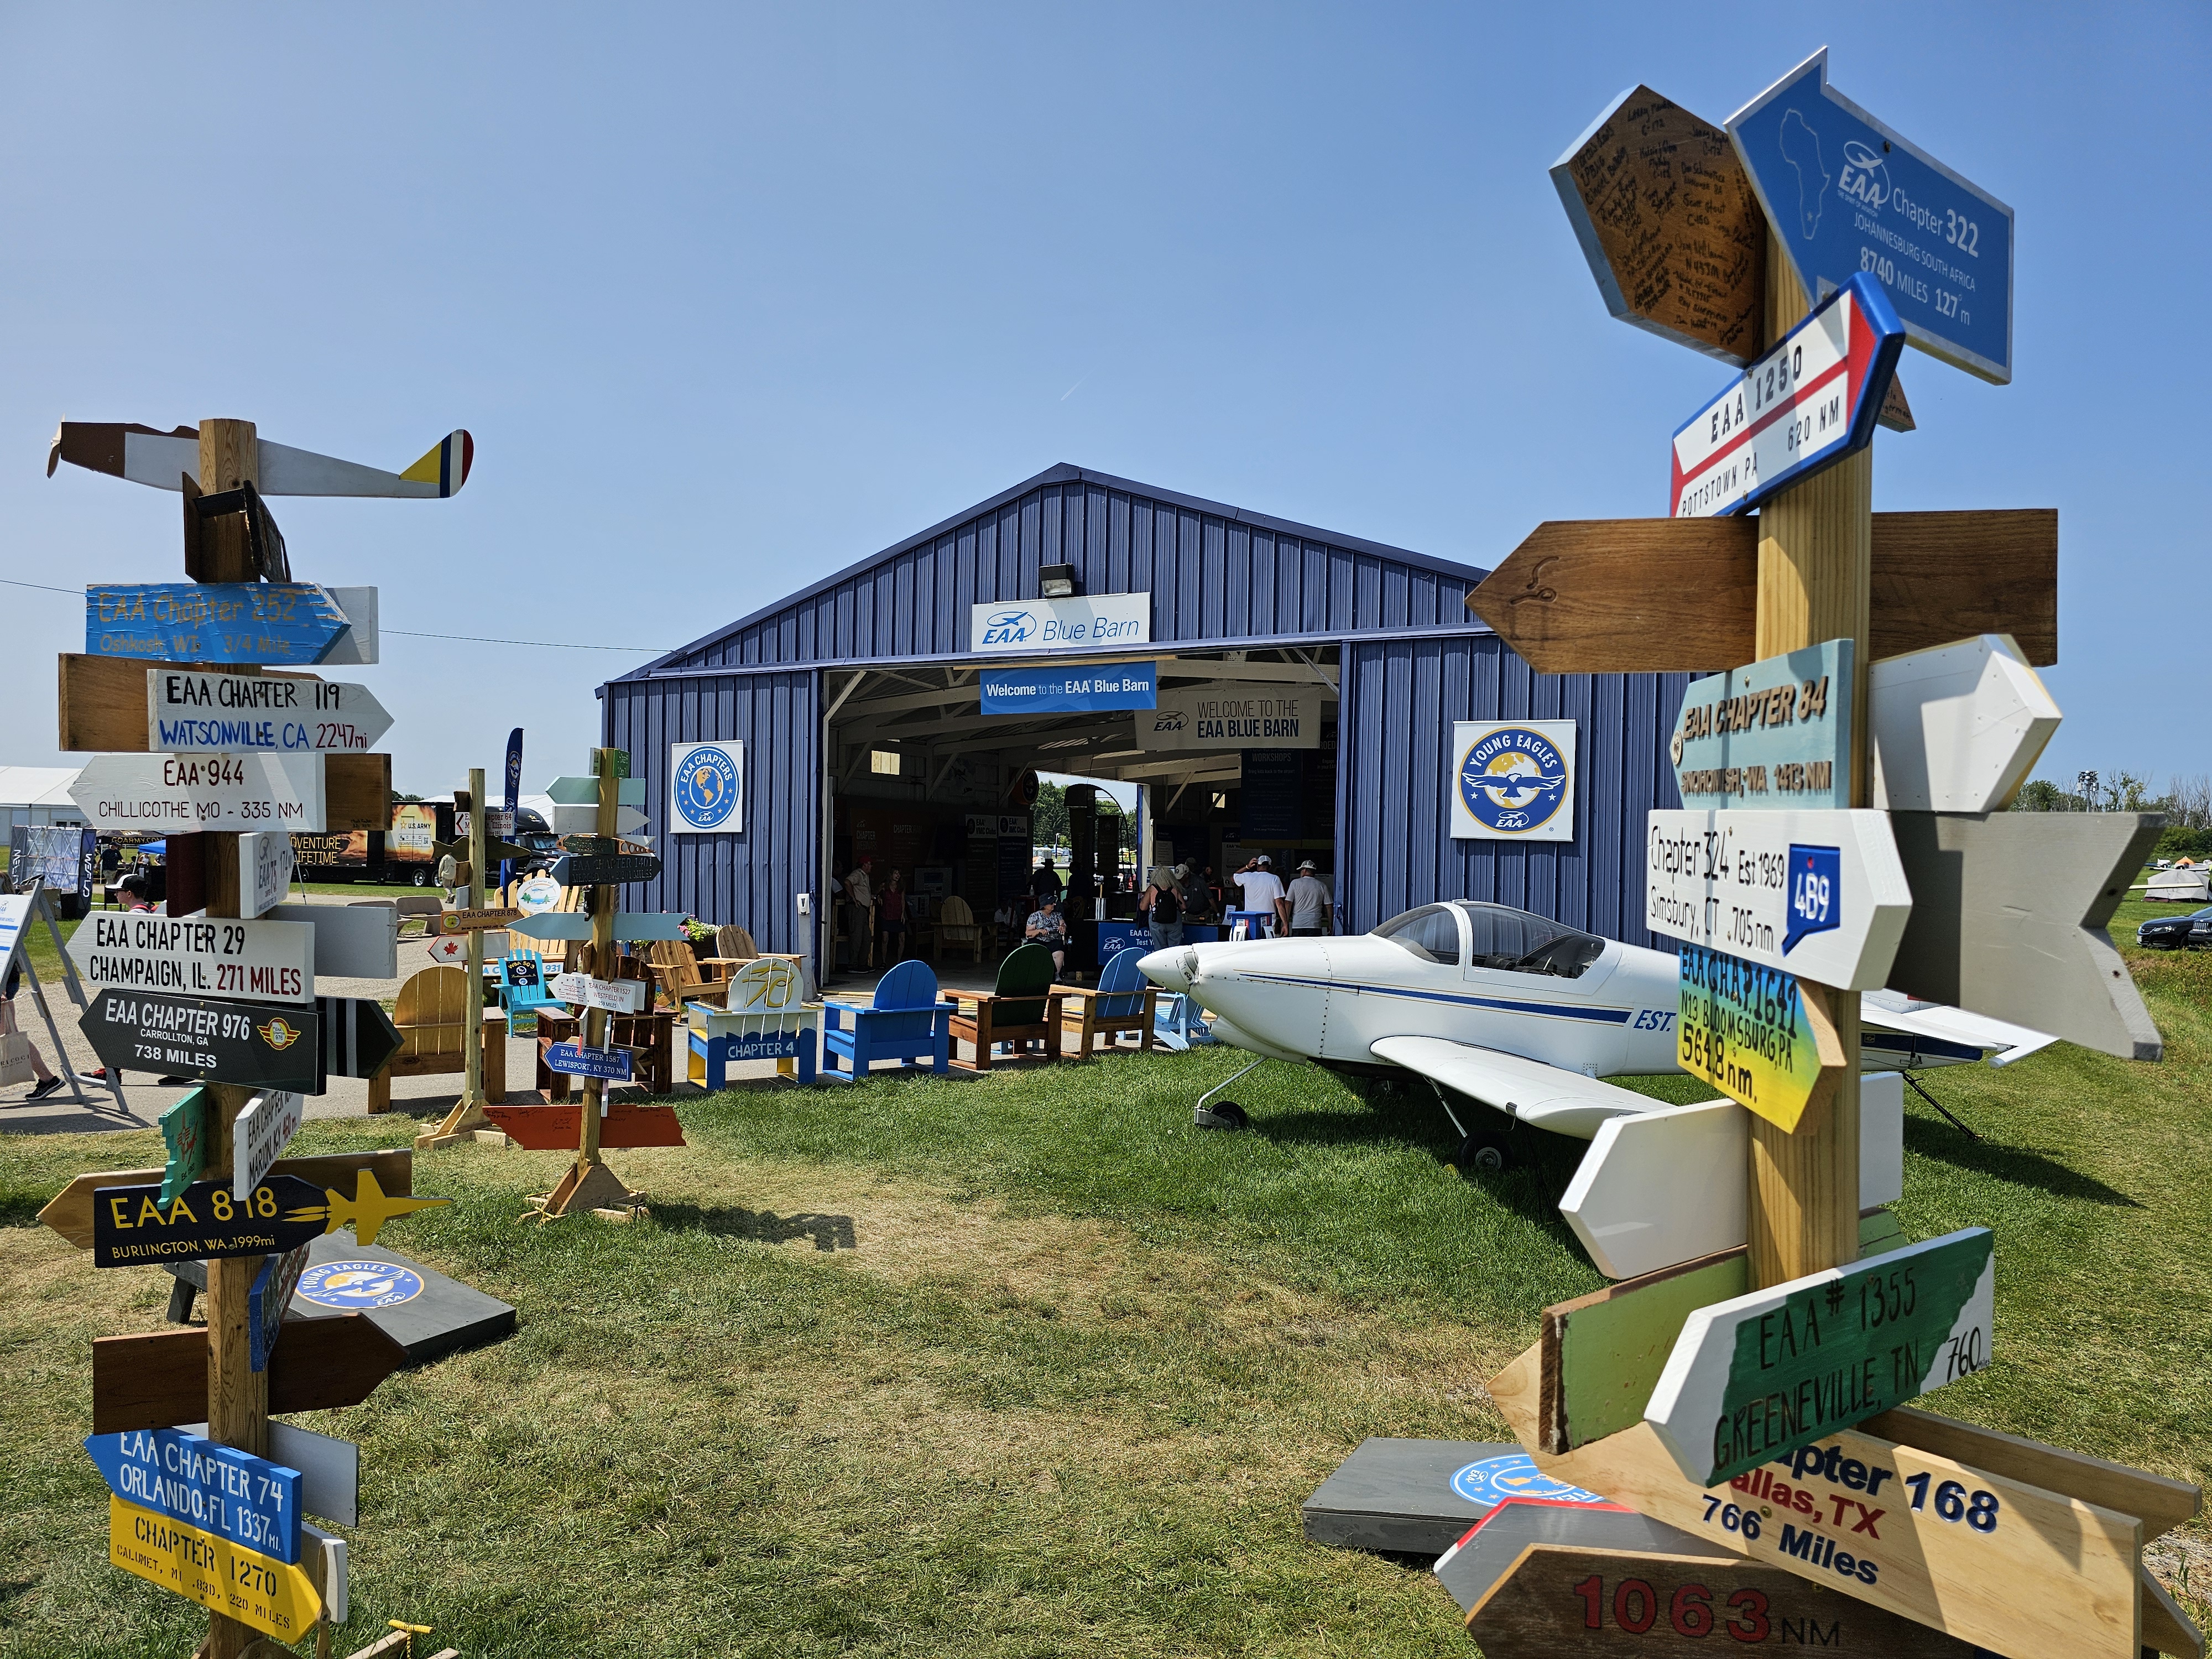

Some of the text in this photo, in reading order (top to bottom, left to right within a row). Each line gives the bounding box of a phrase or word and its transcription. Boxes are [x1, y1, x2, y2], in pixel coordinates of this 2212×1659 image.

[1838, 164, 1881, 208] EAA
[1893, 187, 1979, 258] Chapter 322
[1854, 212, 1975, 293] JOHANNESBURG SOUTH AFRICA
[1860, 246, 1928, 304] 8740 MILES
[1710, 345, 1802, 445] EAA 1250
[1788, 395, 1839, 452] 620 NM
[1682, 452, 1758, 517] POTTSTOWN PA
[98, 593, 296, 629] EAA Chapter 252
[100, 634, 291, 655] Oshkosh, WI 3/4 Mile
[982, 617, 1140, 644] EAA Blue Barn
[166, 676, 340, 710] EAA CHAPTER 119
[986, 679, 1149, 697] Welcome to the Blue Barn
[1197, 700, 1298, 718] WELCOME TO THE
[1682, 675, 1828, 744] EAA CHAPTER 84
[159, 720, 310, 749] WATSONVILLE, CA
[1152, 718, 1299, 738] EAA EAA BLUE BARN
[1252, 753, 1291, 762] WORKSHOPS
[1469, 734, 1558, 768] YOUNG EAGLES
[164, 759, 244, 786] EAA 944
[680, 753, 733, 784] EAA CHAPTERS
[1680, 760, 1832, 797] SNOHOMISH, WA 1413 NM
[98, 801, 304, 819] CHILLICOTHE MO 335 NM
[1495, 819, 1523, 828] EAA
[290, 837, 341, 850] DVENTURE
[857, 830, 876, 841] CHAPTER
[572, 856, 653, 871] EAA CHAPTER 1401
[633, 869, 653, 879] MILES
[1651, 825, 1785, 891] Chapter 324 Est 1969
[1650, 885, 1719, 940] Simsbury, CT
[97, 919, 246, 955] EAA CHAPTER 29
[1103, 942, 1121, 951] EAA
[90, 956, 301, 996] CHAMPAIGN, IL. 271 MILES
[508, 961, 521, 969] WBA
[545, 964, 561, 972] 931
[1682, 943, 1752, 1015] EAA CHAP.
[593, 992, 619, 1002] WESTFIELD,
[599, 984, 619, 993] CHAPTER
[106, 999, 250, 1041] EAA CHAPTER 976
[1633, 1010, 1677, 1032] EST.
[1681, 989, 1698, 1022] N13
[140, 1028, 209, 1046] CARROLLTON, GA
[728, 1042, 795, 1058] CHAPTER 4
[134, 1044, 217, 1068] 738 MILES
[554, 1059, 592, 1073] LEWISPORT,
[615, 1067, 628, 1076] NM
[560, 1048, 620, 1063] EAA CHAPTER 1587
[1682, 1021, 1757, 1104] 564.8 nm.
[249, 1116, 259, 1150] EAA
[273, 1121, 281, 1152] KY
[110, 1187, 278, 1229] EAA 818
[112, 1238, 228, 1259] BURLINGTON, WA
[302, 1264, 388, 1290] YOUNG EAGLES
[377, 1296, 404, 1306] EAA
[1760, 1267, 1916, 1371] EAA 1355
[1890, 1337, 1919, 1395] TN
[1947, 1327, 1981, 1383] 760
[120, 1431, 284, 1512] EAA CHAPTER 74
[1828, 1494, 1886, 1541] TX
[1905, 1471, 2000, 1534] 168
[1702, 1494, 1880, 1585] 766 Miles
[134, 1516, 277, 1598] CHAPTER 1270
[116, 1545, 291, 1630] CALUMET, MI 220 MILES
[1574, 1575, 1840, 1647] 1063 NM
